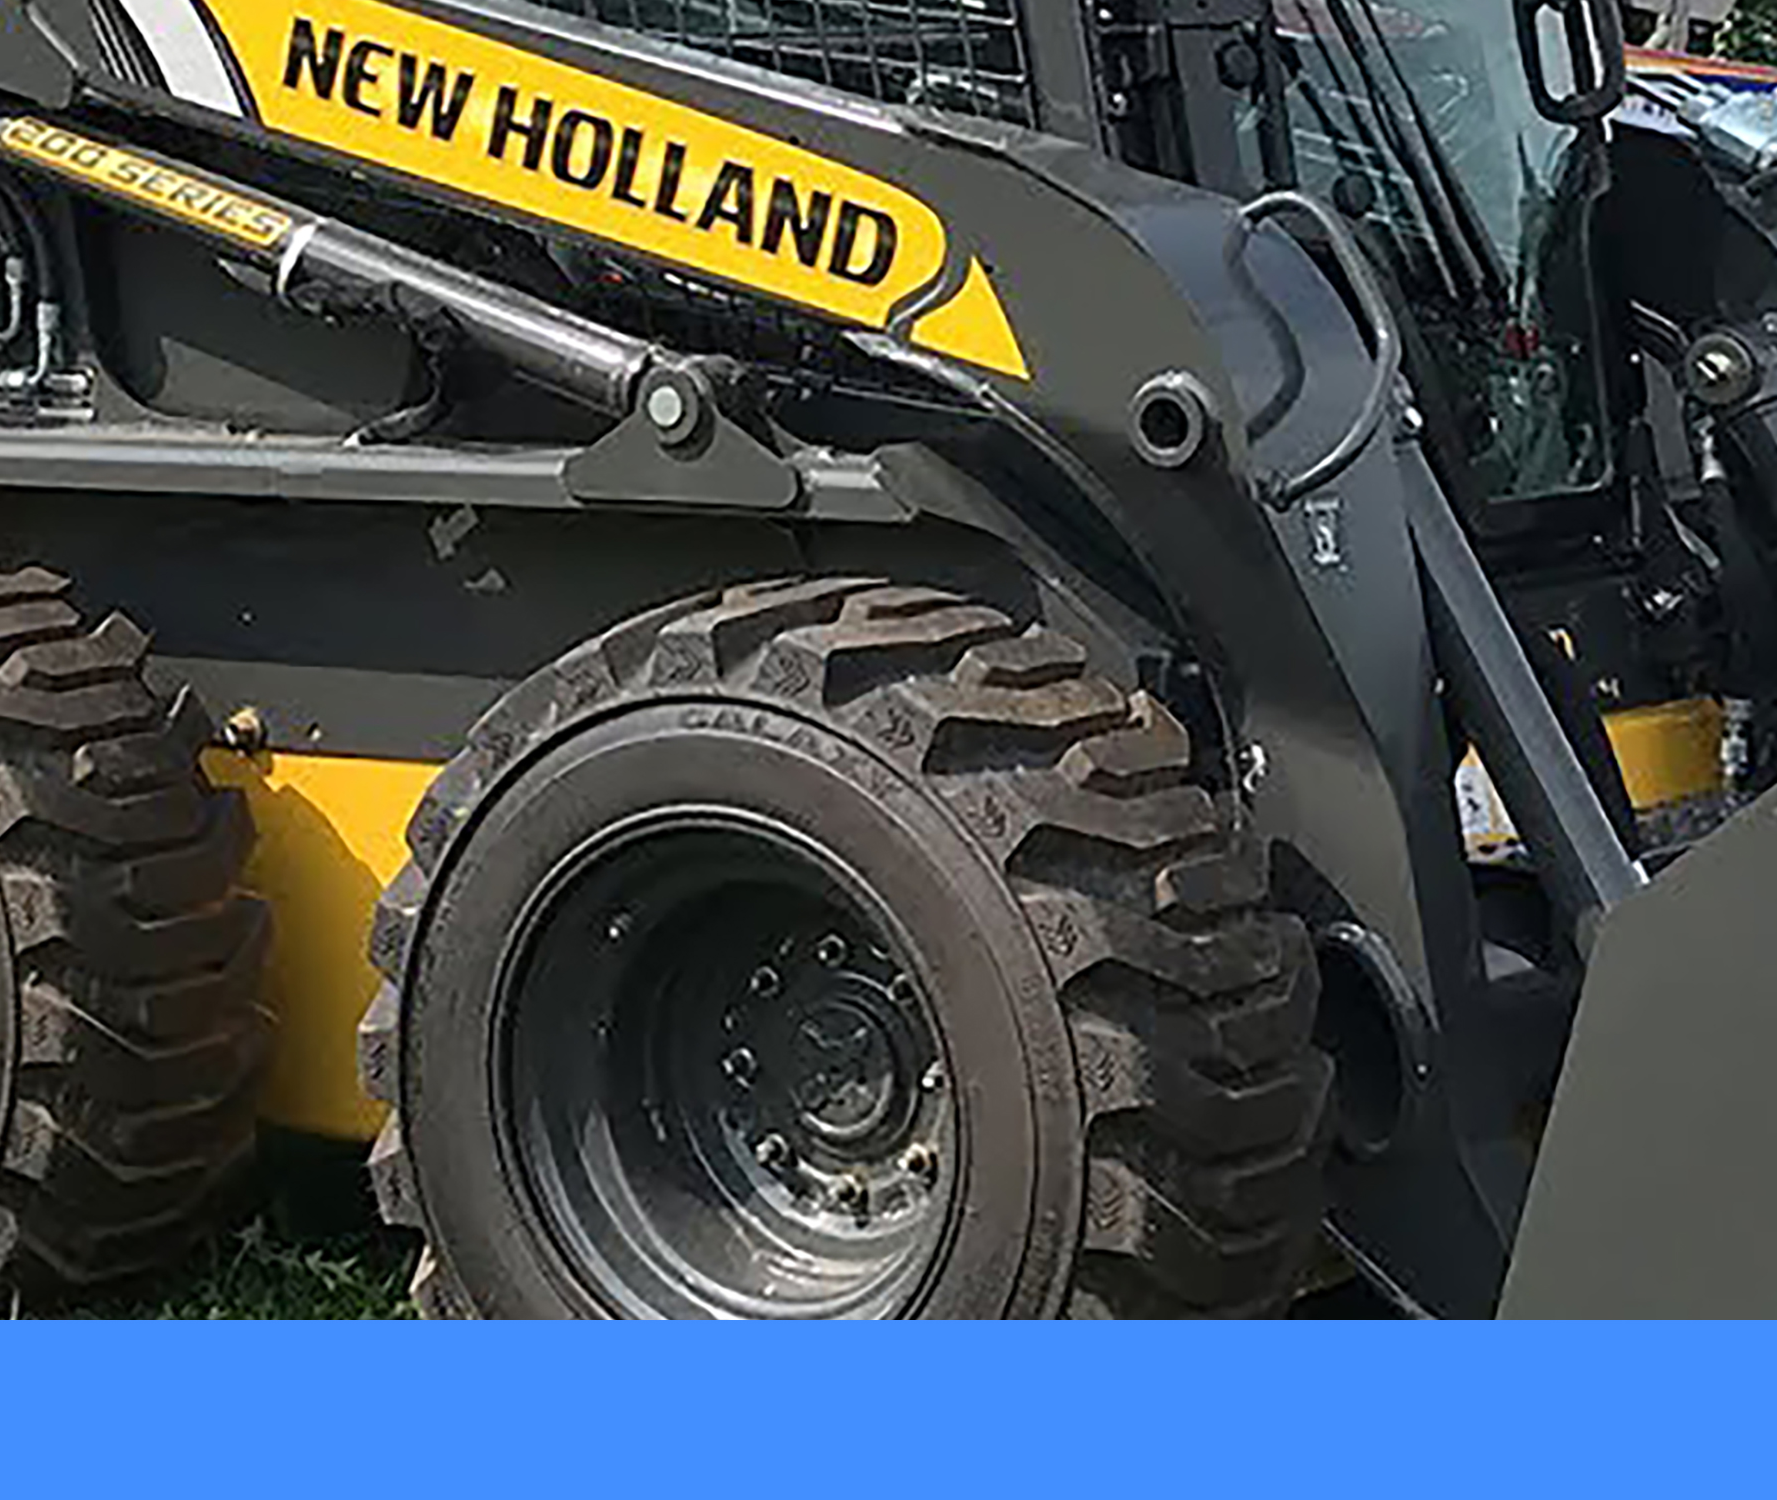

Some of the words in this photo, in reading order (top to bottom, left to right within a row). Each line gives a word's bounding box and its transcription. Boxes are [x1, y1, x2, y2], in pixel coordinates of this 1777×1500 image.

[8, 115, 107, 169] 200
[109, 151, 290, 236] SERIES
[282, 17, 475, 142] NEW
[486, 85, 899, 288] HOLLAND
